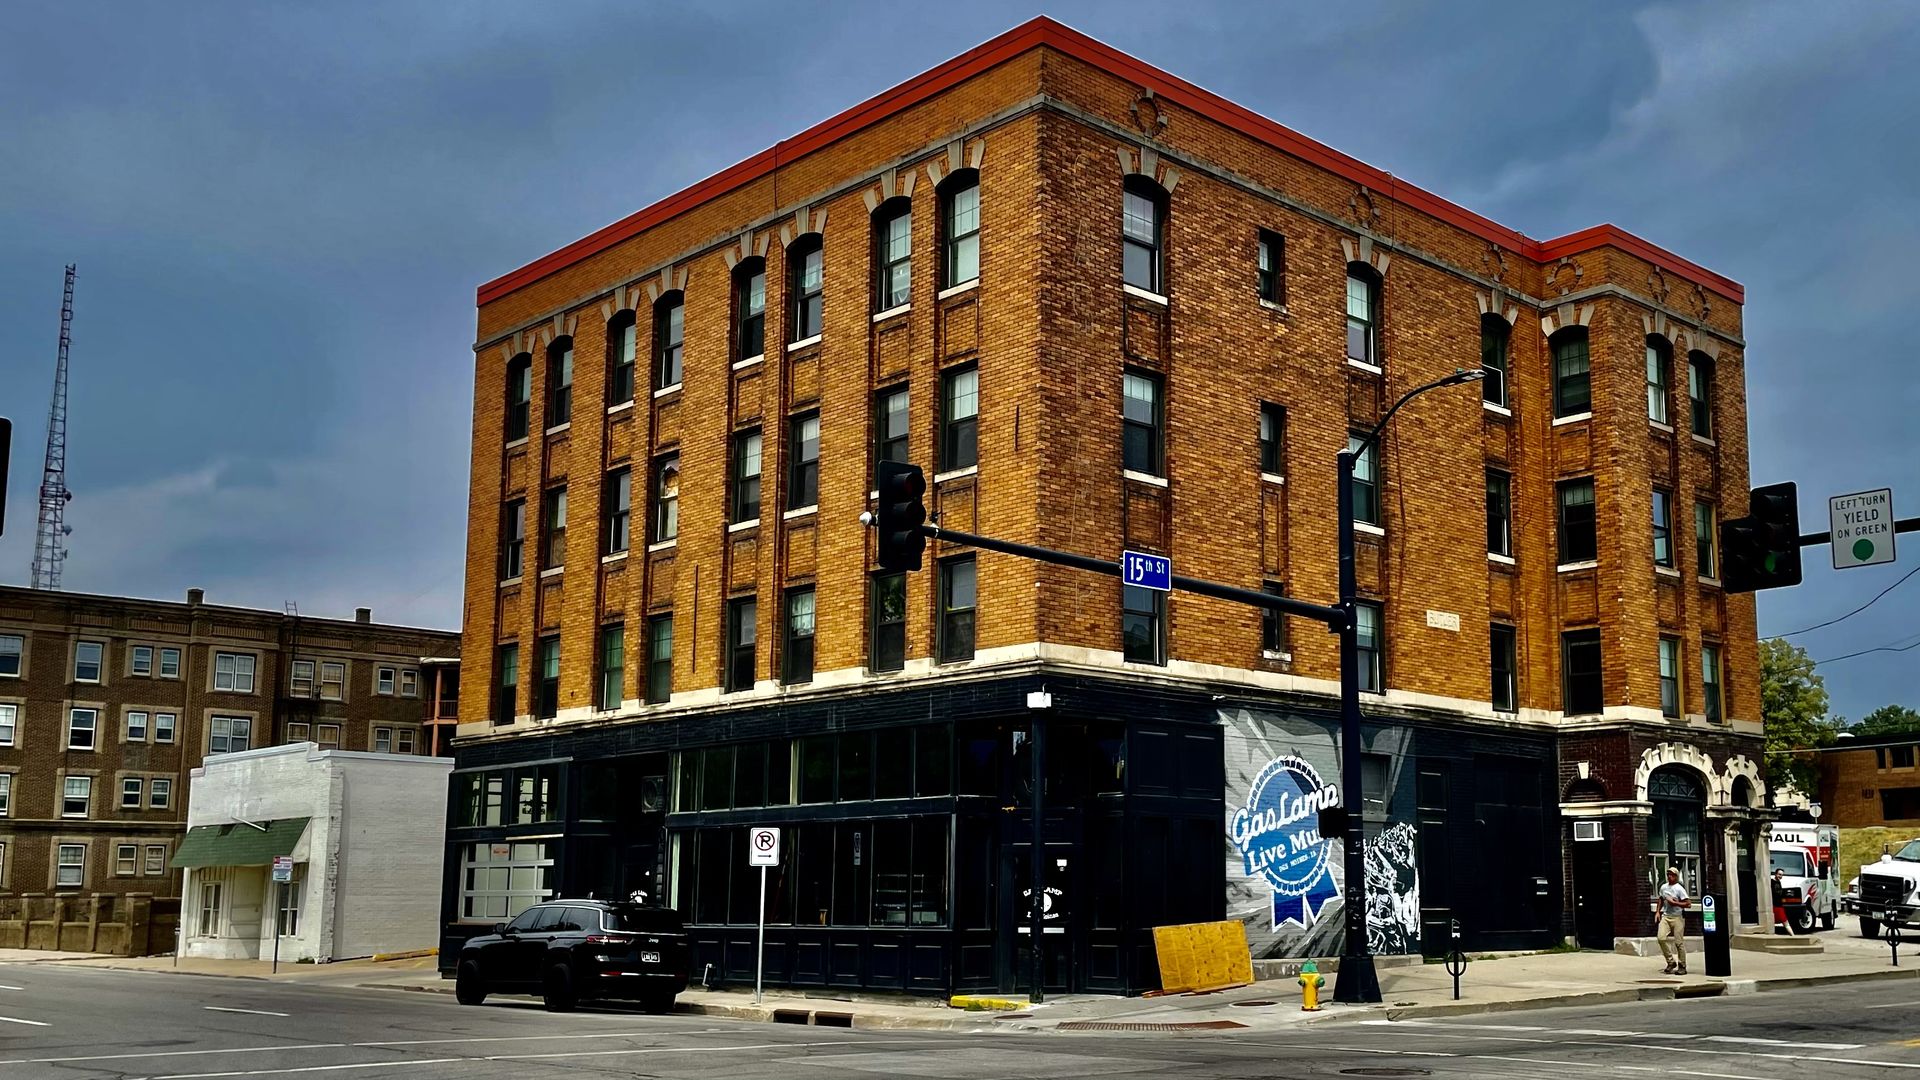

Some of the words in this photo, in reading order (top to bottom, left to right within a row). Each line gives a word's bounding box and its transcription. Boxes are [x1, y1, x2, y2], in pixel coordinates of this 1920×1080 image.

[1835, 499, 1857, 510] LEFT
[1861, 494, 1886, 506] TURN
[1844, 508, 1879, 524] YIELD
[1837, 528, 1850, 539] ON
[1855, 522, 1887, 536] GREEN
[1129, 556, 1153, 582] 15th
[1156, 561, 1165, 575] St
[1247, 843, 1287, 872] Live
